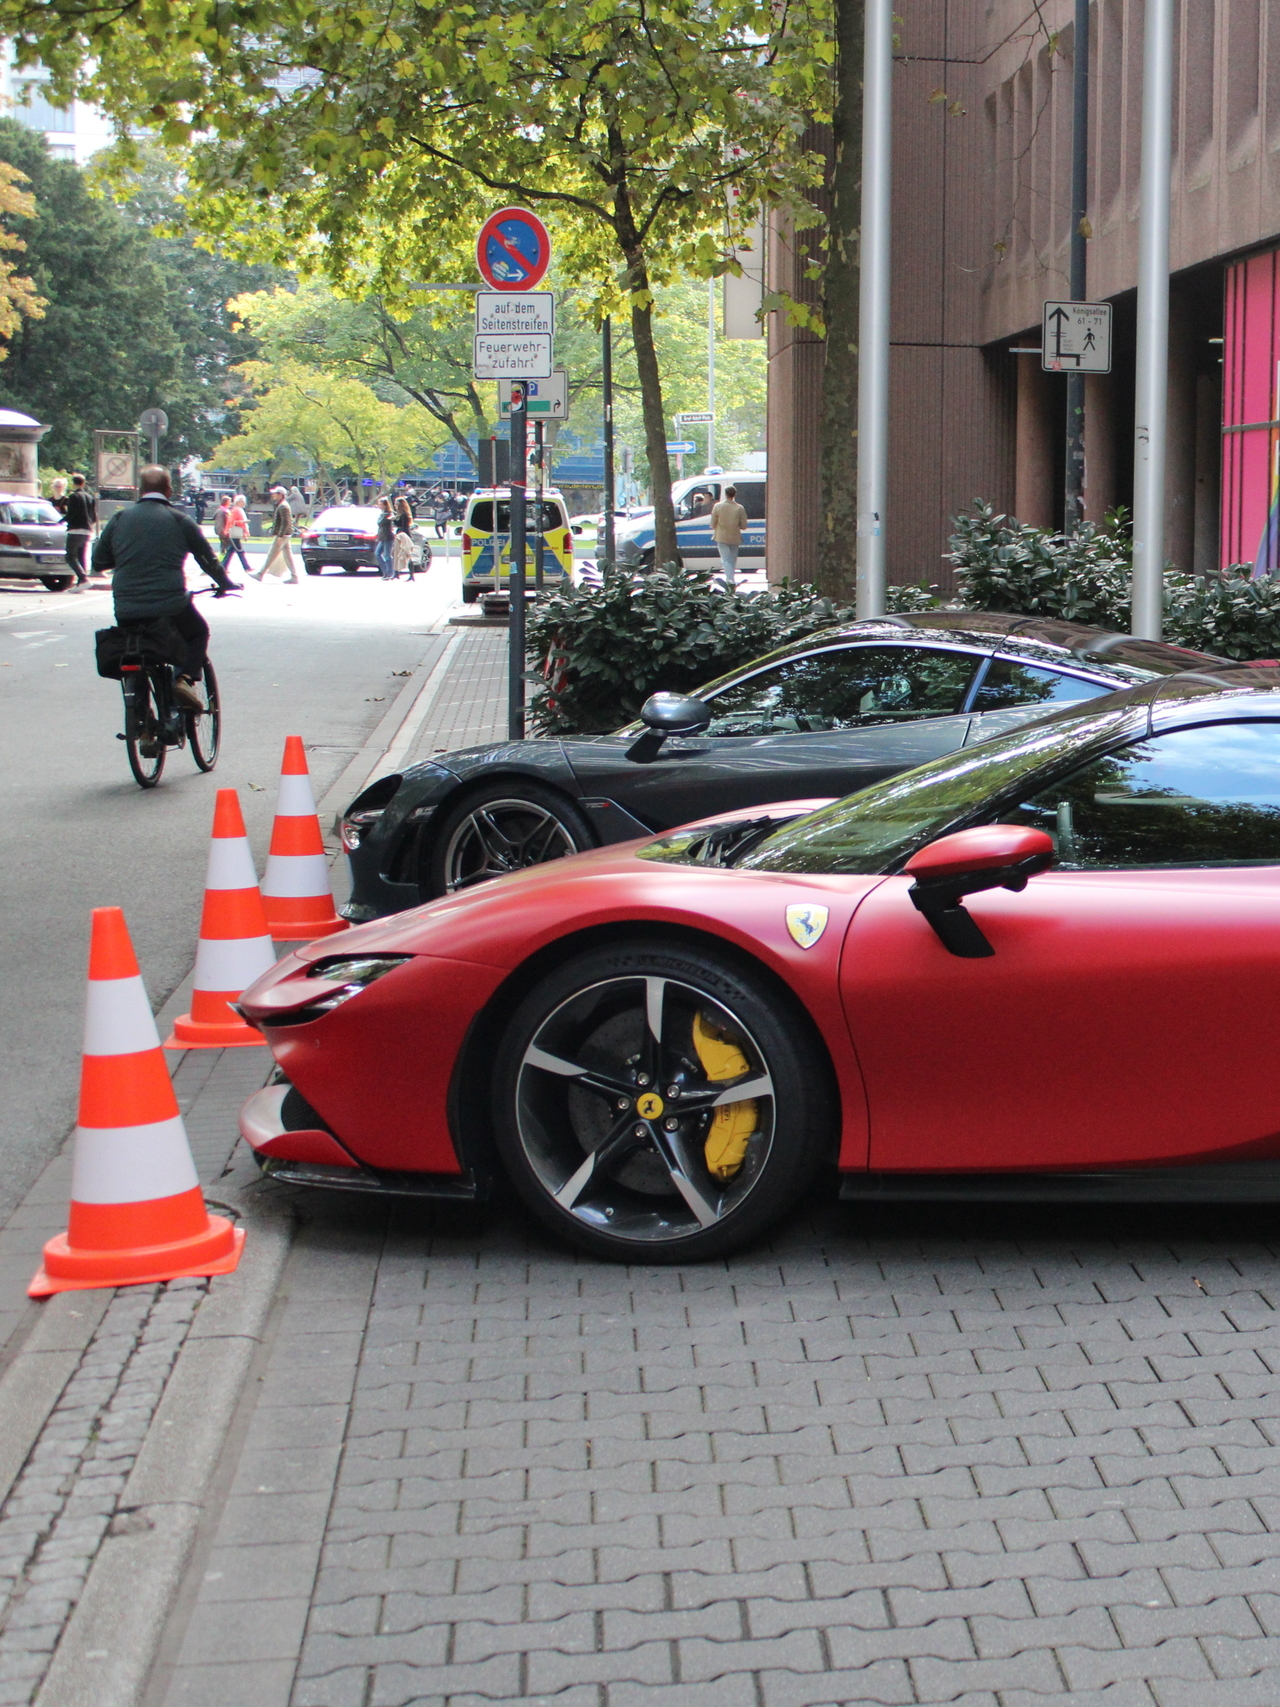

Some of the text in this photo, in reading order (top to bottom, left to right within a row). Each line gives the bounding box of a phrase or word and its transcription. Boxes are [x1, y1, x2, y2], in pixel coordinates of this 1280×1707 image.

[495, 301, 535, 314] auf dem
[1073, 306, 1107, 317] Königsallee
[482, 318, 548, 330] Seitenstreifen
[1077, 317, 1085, 325] 61
[1094, 317, 1102, 326] 71
[479, 341, 547, 352] Feuerwehr-
[492, 357, 534, 368] zufahrt
[471, 539, 506, 547] POLIEI
